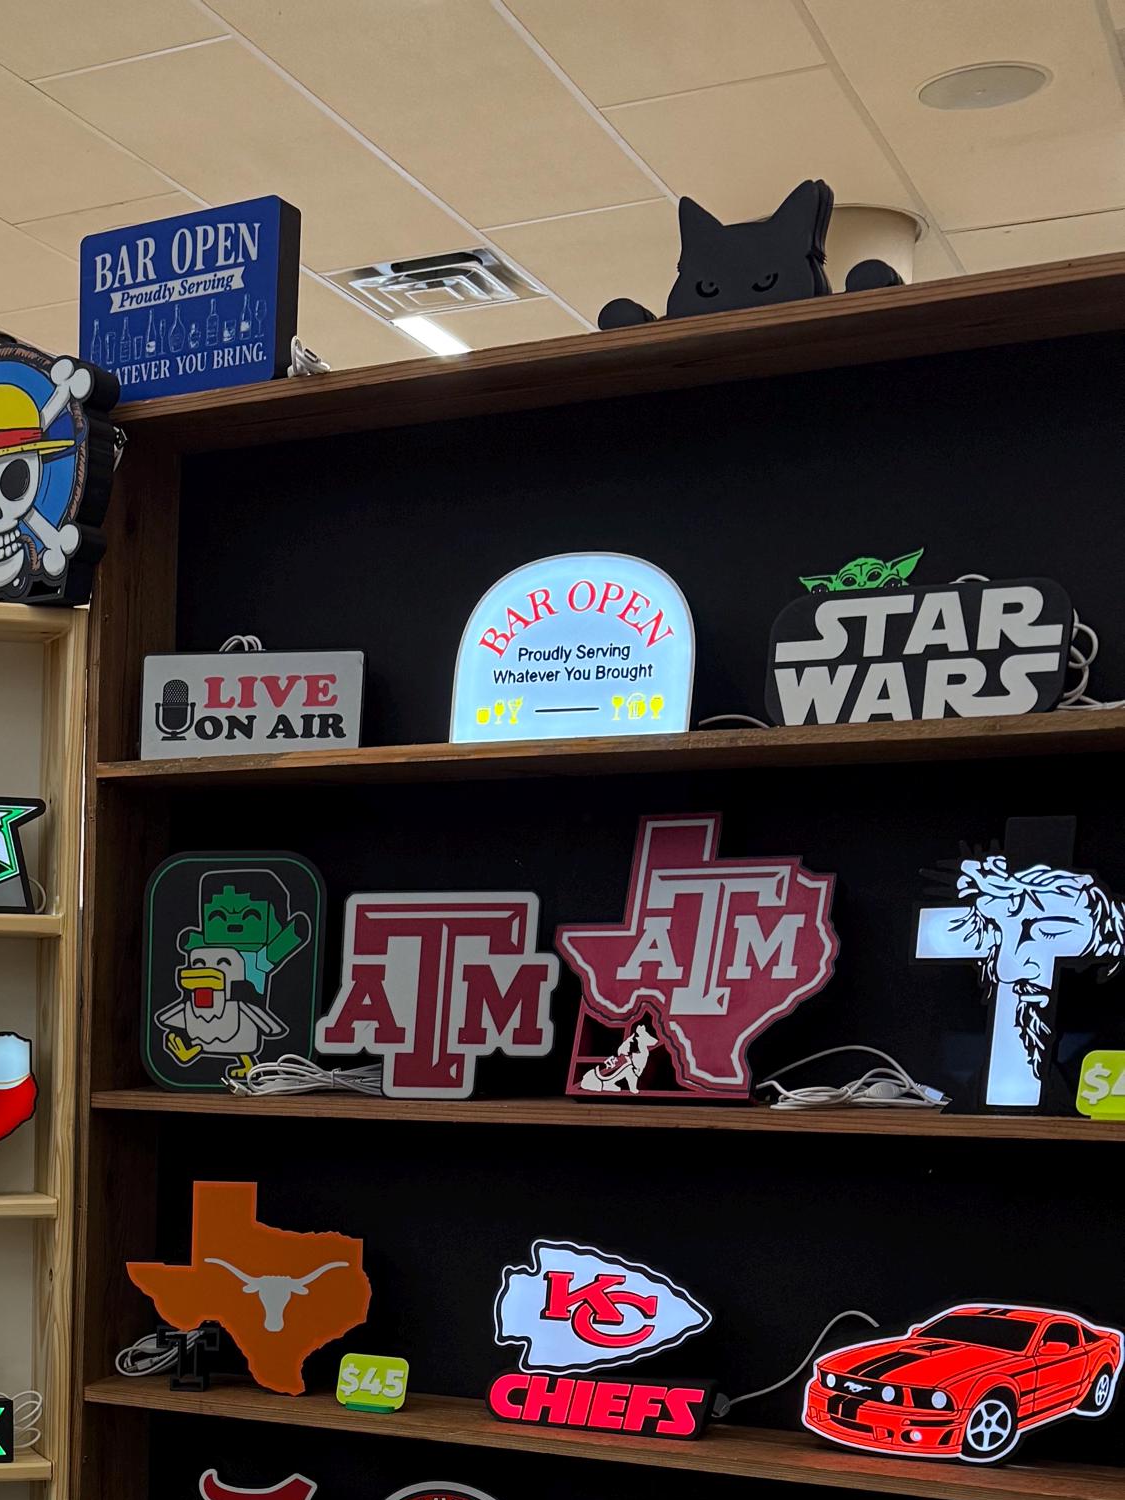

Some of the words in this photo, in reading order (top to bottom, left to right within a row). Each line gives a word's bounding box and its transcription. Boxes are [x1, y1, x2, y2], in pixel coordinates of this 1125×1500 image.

[94, 237, 157, 293] BAR
[172, 222, 261, 274] OPEN
[118, 282, 175, 309] Proudly
[178, 273, 235, 298] Serving
[107, 359, 170, 387] ATEVER
[176, 352, 207, 376] YOU
[212, 342, 267, 369] BRING.
[479, 588, 558, 658] BAR
[567, 580, 674, 648] OPEN
[775, 586, 1064, 662] STAR
[493, 669, 560, 685] Whatever
[565, 666, 591, 681] You
[596, 663, 653, 681] Brought
[518, 645, 572, 664] Proudly
[576, 643, 631, 661] Serving
[203, 674, 338, 709] LIVE
[774, 652, 1061, 726] WARS
[194, 714, 257, 741] ON
[266, 713, 347, 739] AIR
[541, 1271, 658, 1348] KC
[340, 1361, 405, 1398] $45
[489, 1373, 705, 1437] CHIEFS
